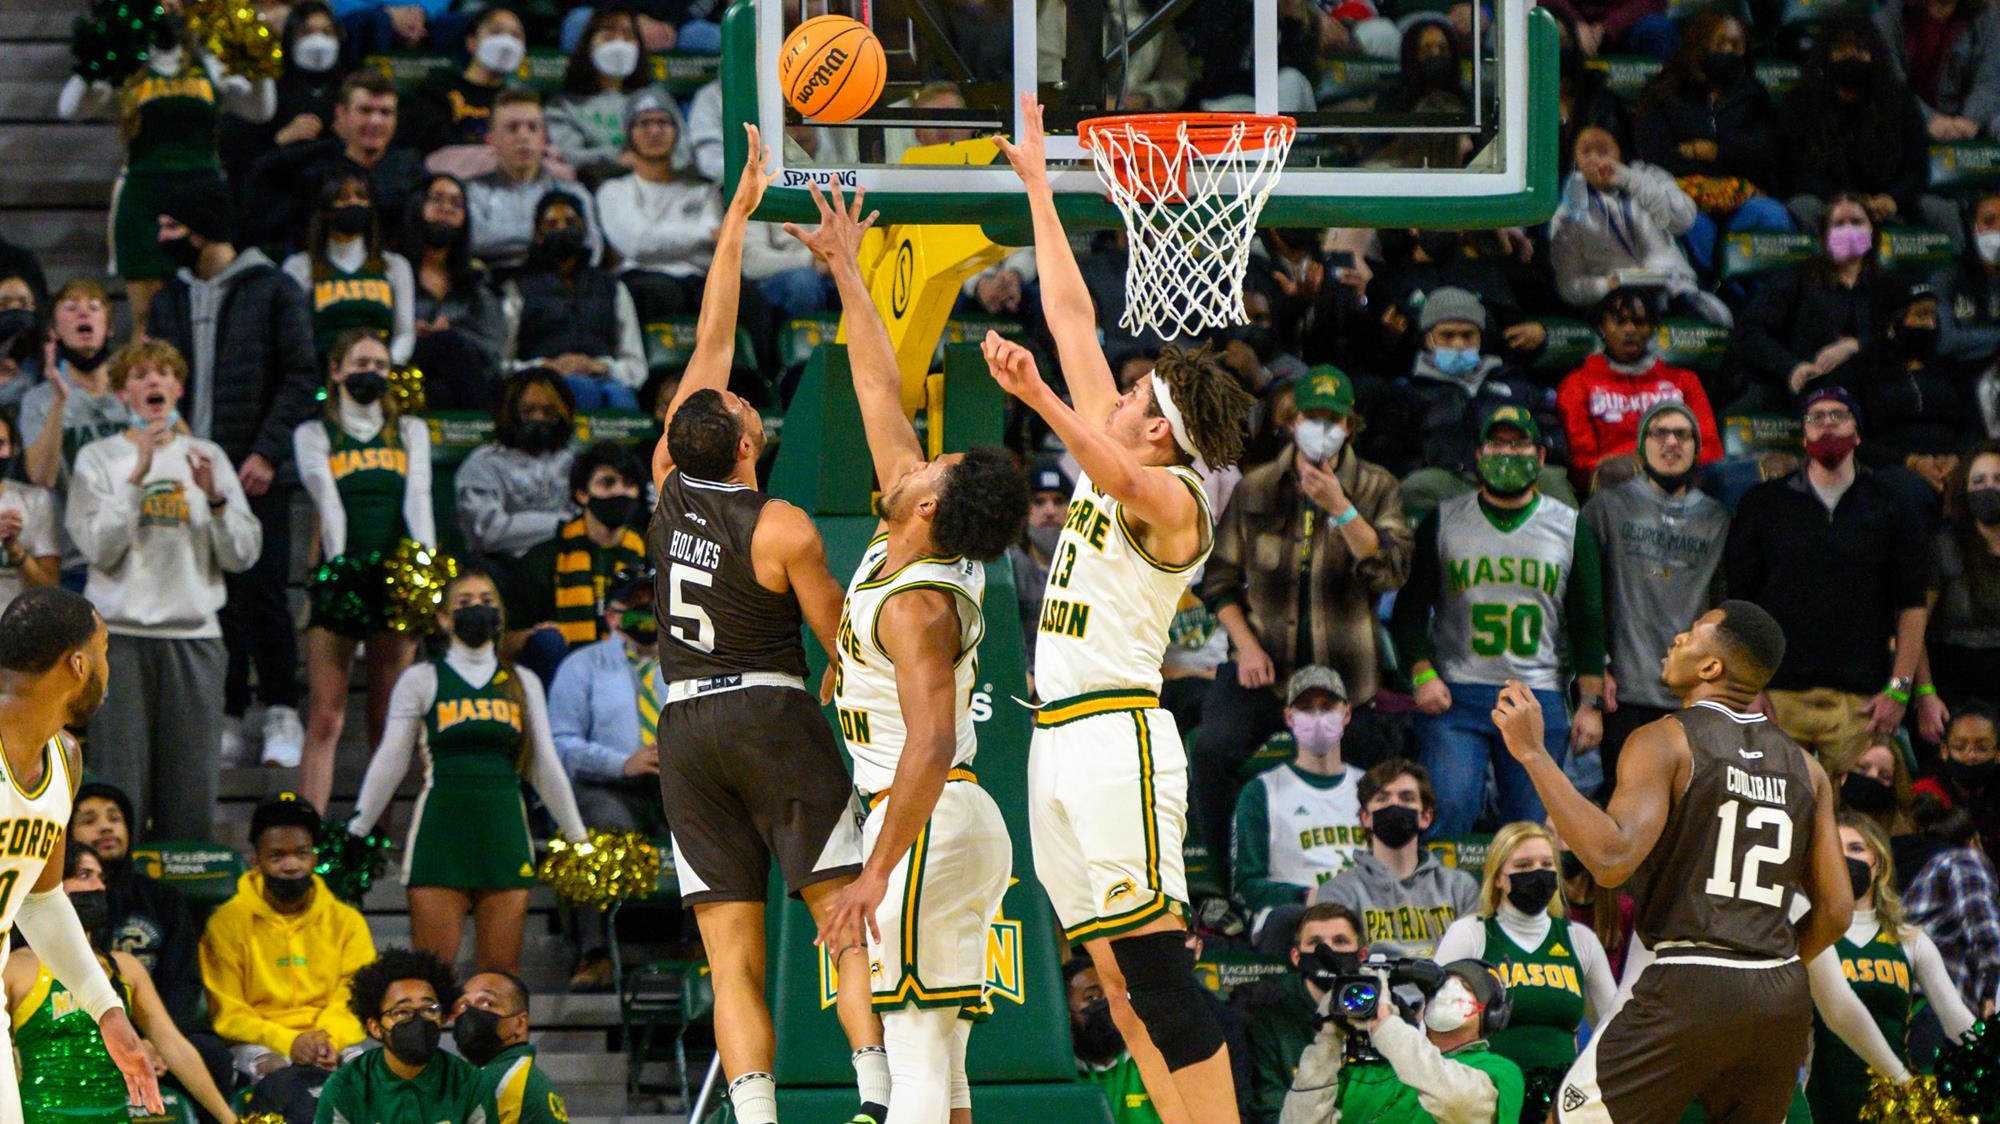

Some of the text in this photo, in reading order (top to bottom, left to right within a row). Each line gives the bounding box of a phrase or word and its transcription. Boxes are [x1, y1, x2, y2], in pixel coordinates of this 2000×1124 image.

[797, 47, 849, 104] Wilson
[784, 170, 857, 187] SPALDNG
[330, 447, 409, 478] MASON
[670, 530, 721, 570] HOLMES
[1050, 541, 1077, 589] 13
[1450, 556, 1561, 597] MASON
[670, 562, 715, 654] 5
[1040, 598, 1090, 639] ASON
[1472, 603, 1544, 657] 50
[437, 699, 523, 734] MASON
[1727, 765, 1787, 805] COULIBALY
[0, 818, 63, 861] EORG
[1300, 825, 1368, 850] GEORG
[1705, 800, 1793, 908] 12
[1365, 905, 1456, 943] PATRIT
[1842, 958, 1910, 994] ASON
